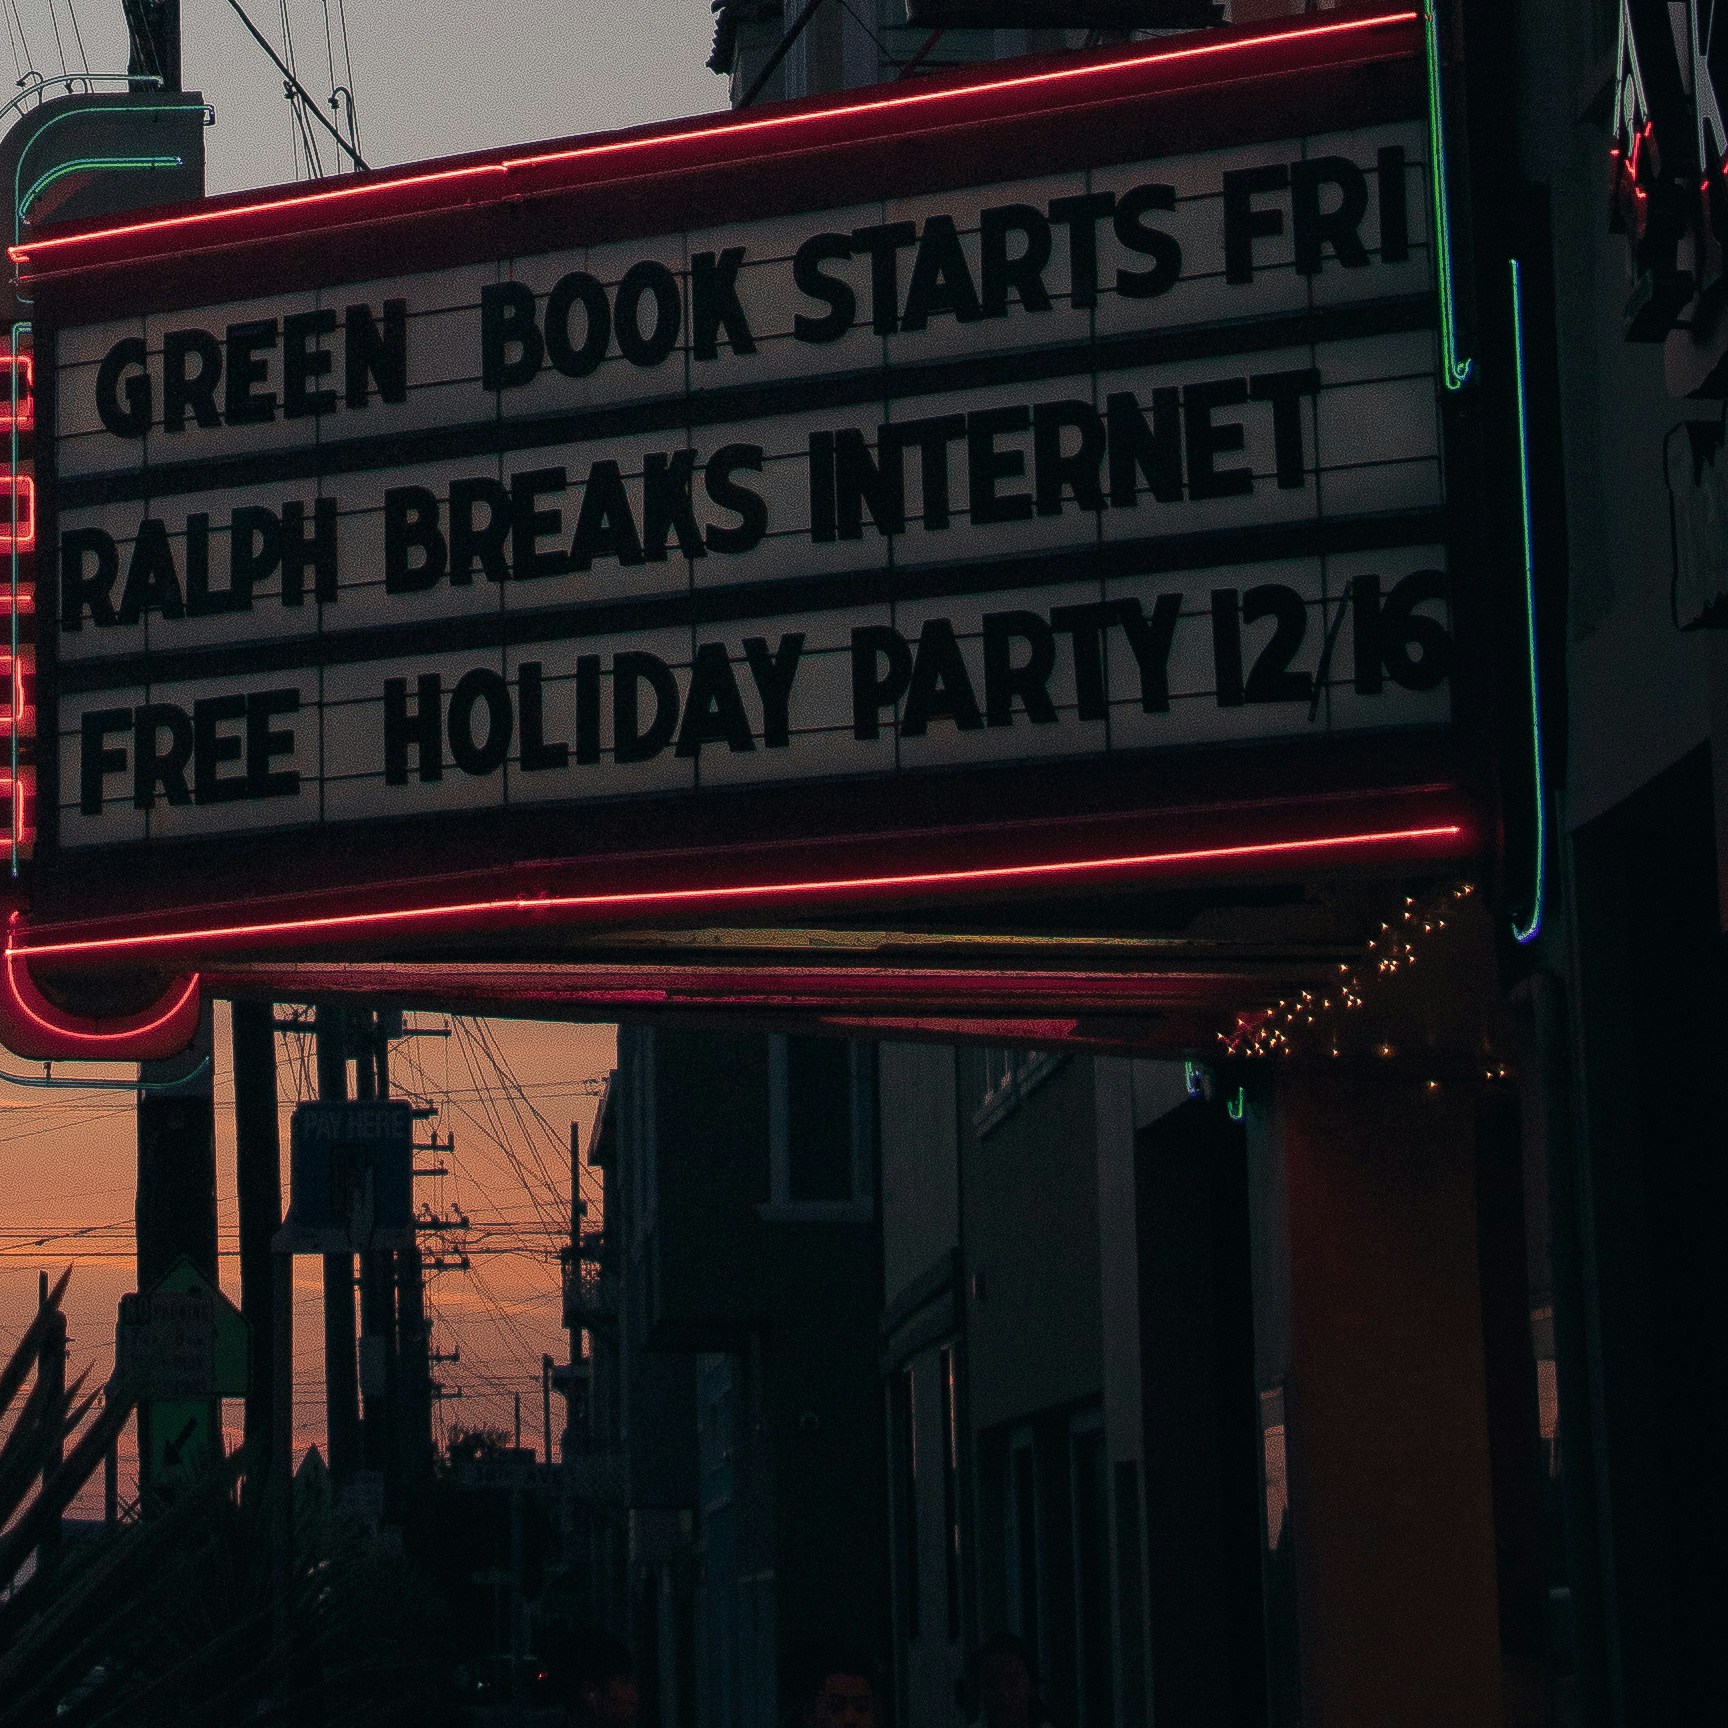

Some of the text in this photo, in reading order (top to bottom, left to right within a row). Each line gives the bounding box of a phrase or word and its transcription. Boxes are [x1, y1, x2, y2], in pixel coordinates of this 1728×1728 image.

[96, 146, 1410, 439] GREEN BOOK STARTS FRI
[61, 368, 1321, 632] RALPH BREAKS INTERNET
[81, 569, 1455, 816] FREE HOLIDAY PARTY 12/16
[304, 1108, 404, 1140] PAY HERE
